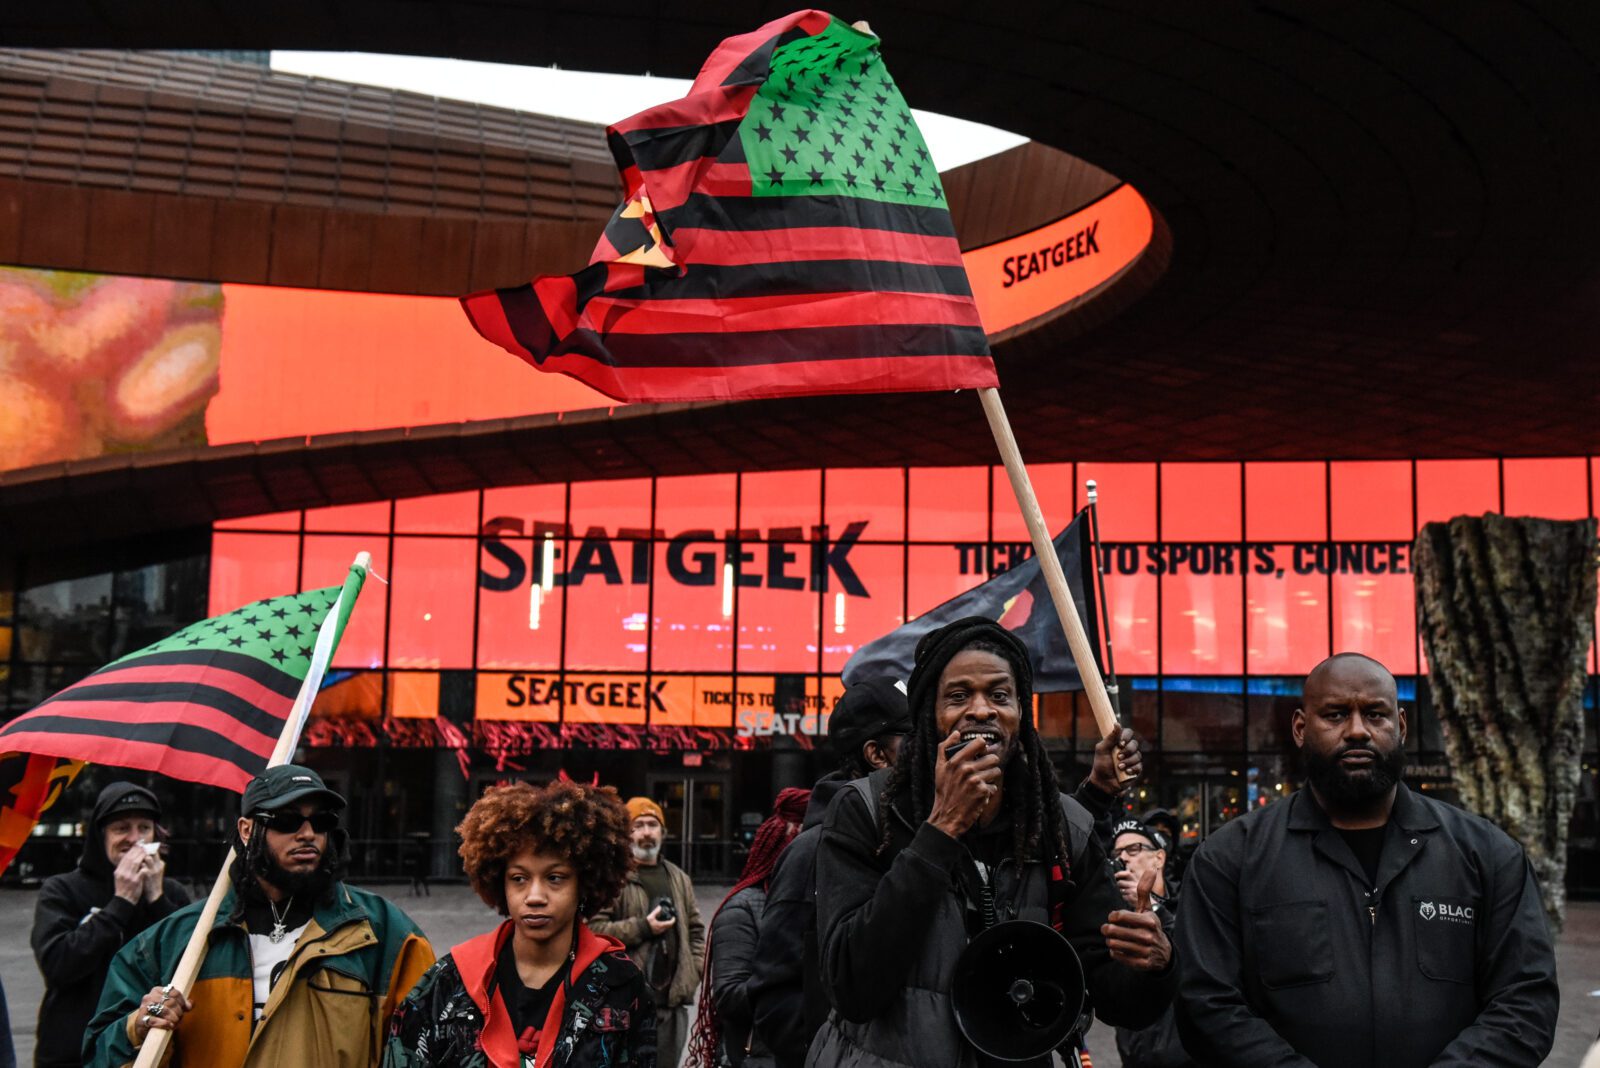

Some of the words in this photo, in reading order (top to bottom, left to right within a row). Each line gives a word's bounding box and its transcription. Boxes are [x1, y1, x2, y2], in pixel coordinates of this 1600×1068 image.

[1002, 220, 1100, 288] SEATGEEK
[479, 516, 871, 598] SEATGEEK
[954, 544, 1038, 577] TICK
[1099, 543, 1139, 575] TO
[1146, 543, 1285, 579] SPORTS,
[1293, 543, 1415, 575] CONCE
[506, 674, 668, 713] SEATGEEK
[1439, 904, 1474, 919] BLAC
